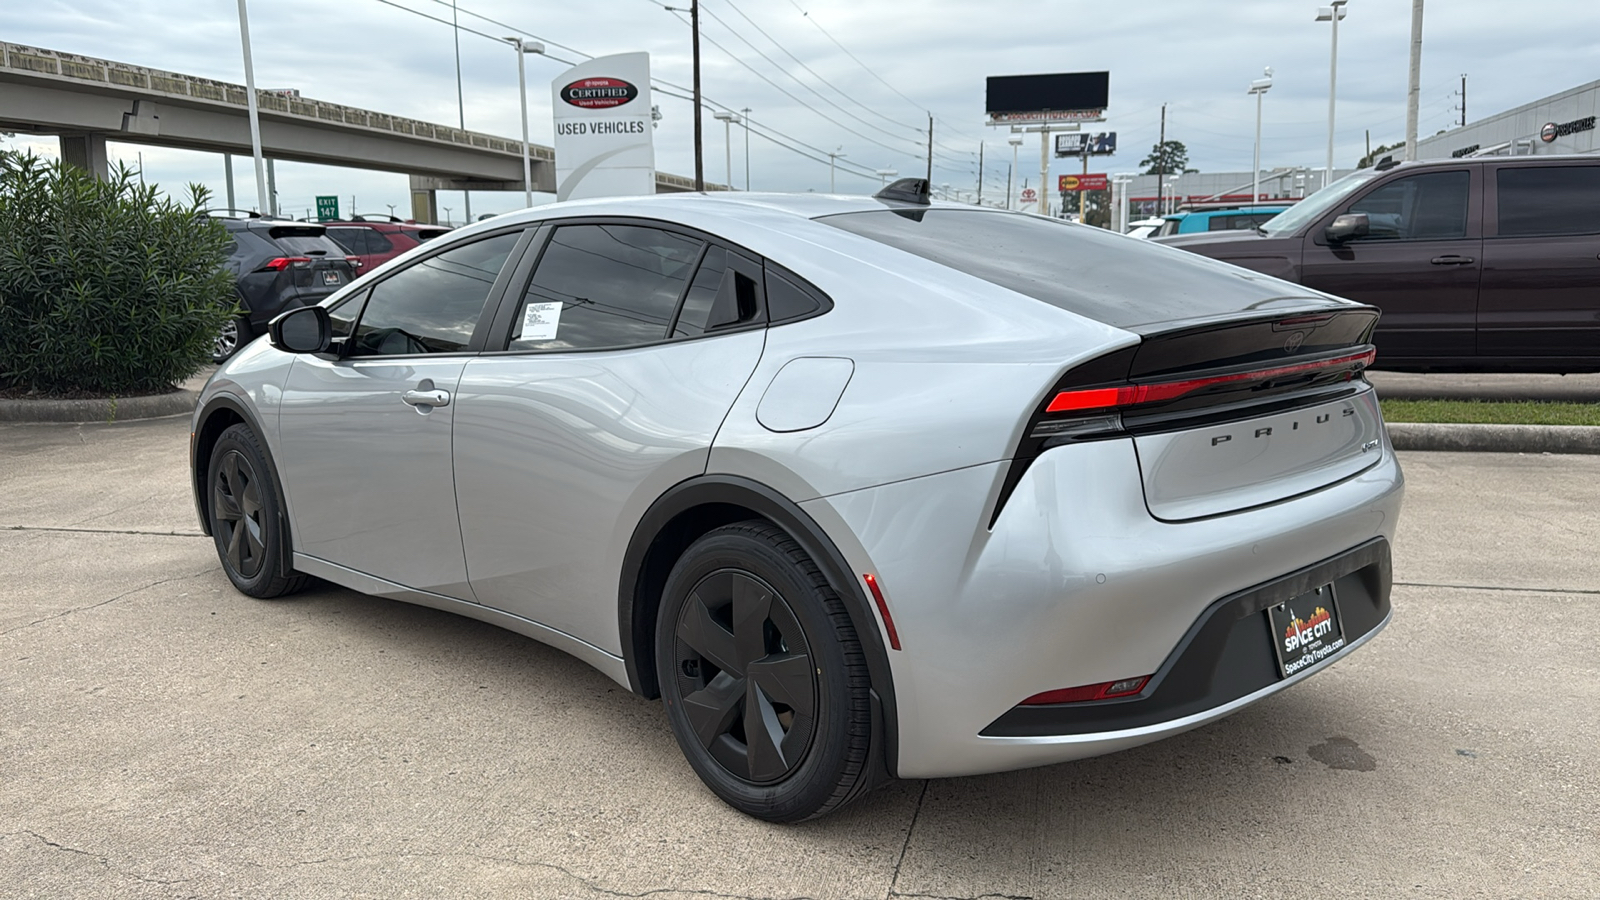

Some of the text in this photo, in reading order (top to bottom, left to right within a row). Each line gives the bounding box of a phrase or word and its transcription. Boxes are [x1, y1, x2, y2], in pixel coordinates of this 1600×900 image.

[557, 121, 644, 135] USED VEHICLES
[320, 207, 335, 217] 147
[1211, 407, 1355, 446] PRIUS
[1284, 618, 1332, 652] SPACE CITY
[1285, 638, 1344, 674] SpaceCityToyota.com
